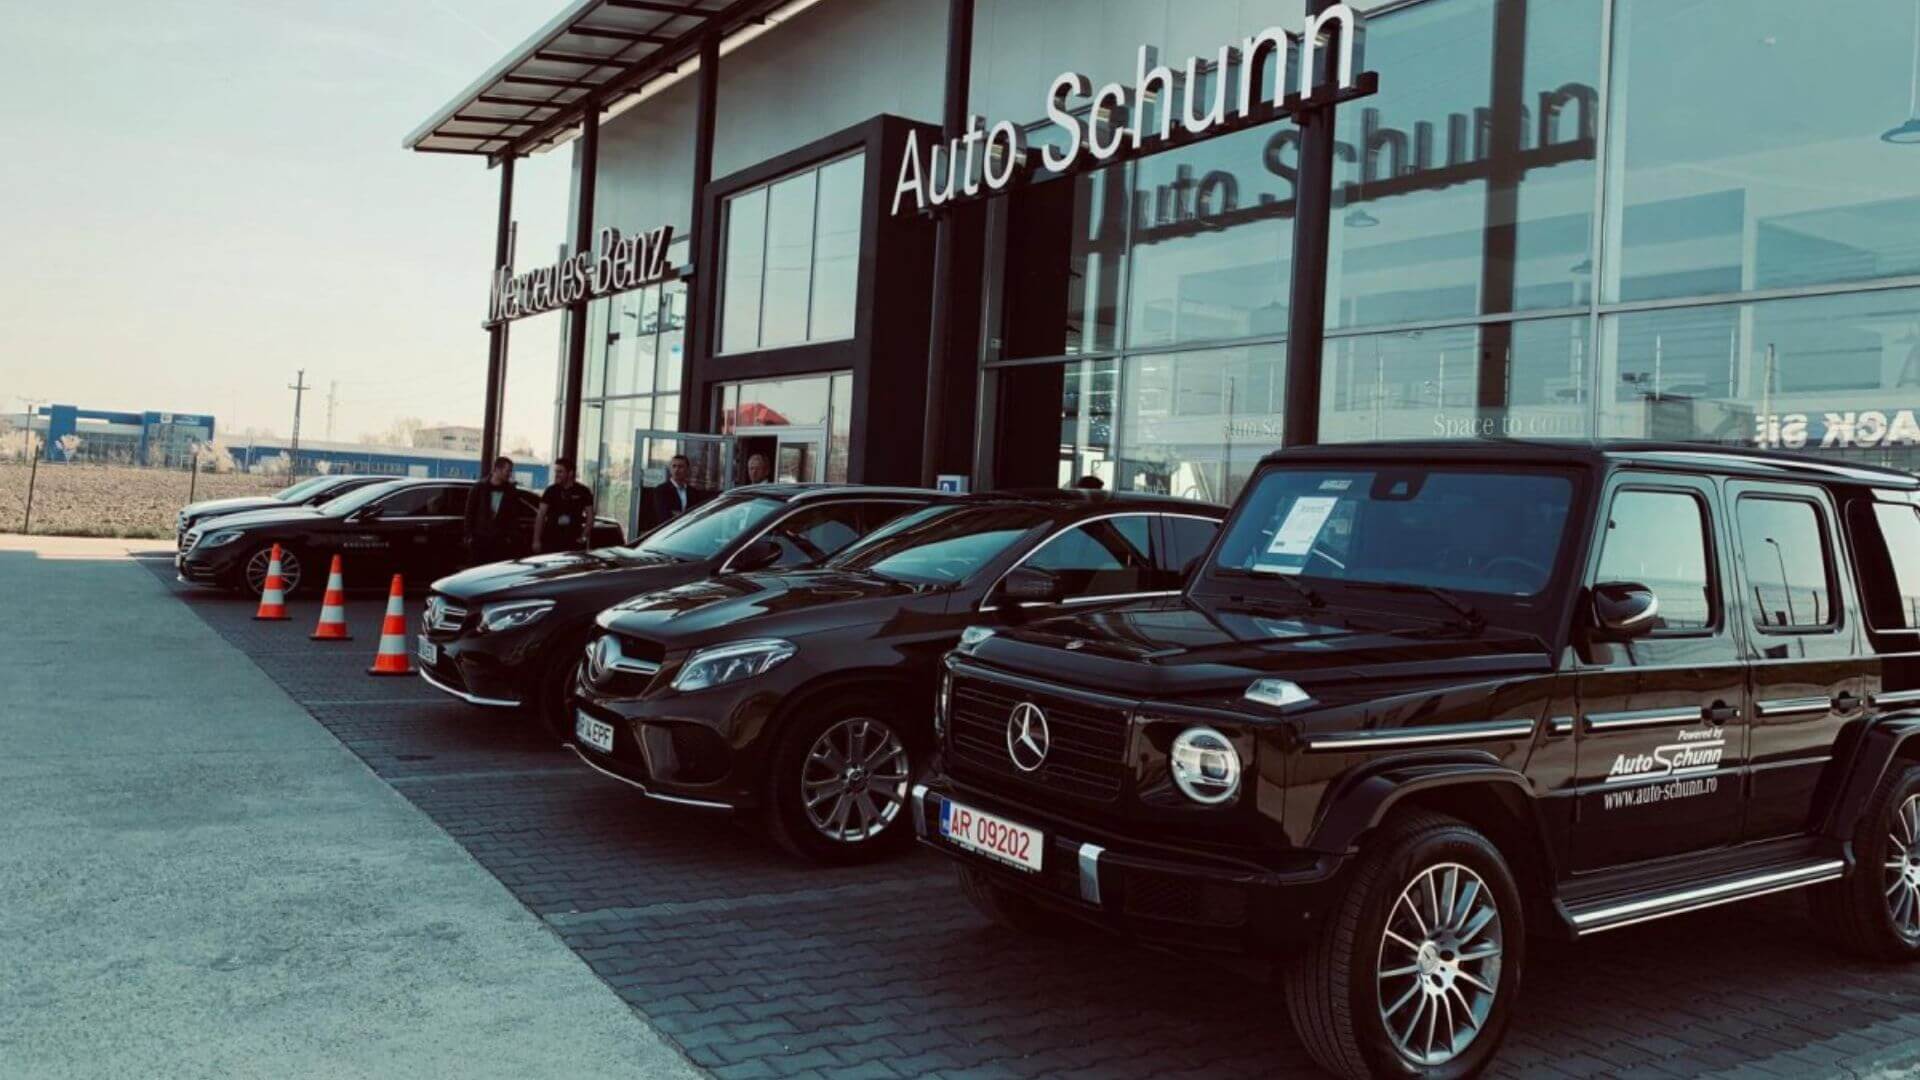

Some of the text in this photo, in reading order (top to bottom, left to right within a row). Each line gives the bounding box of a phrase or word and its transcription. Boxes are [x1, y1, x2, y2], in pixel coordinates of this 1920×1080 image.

[890, 2, 1358, 217] Auto Schunn
[489, 225, 673, 321] Mercedes-Benz
[1433, 414, 1494, 436] Space
[1502, 414, 1522, 434] to
[1678, 728, 1724, 741] Powered by
[1604, 776, 1718, 810] www.auto-schunn.ro
[951, 807, 972, 839] AR
[976, 817, 1030, 861] 09202
